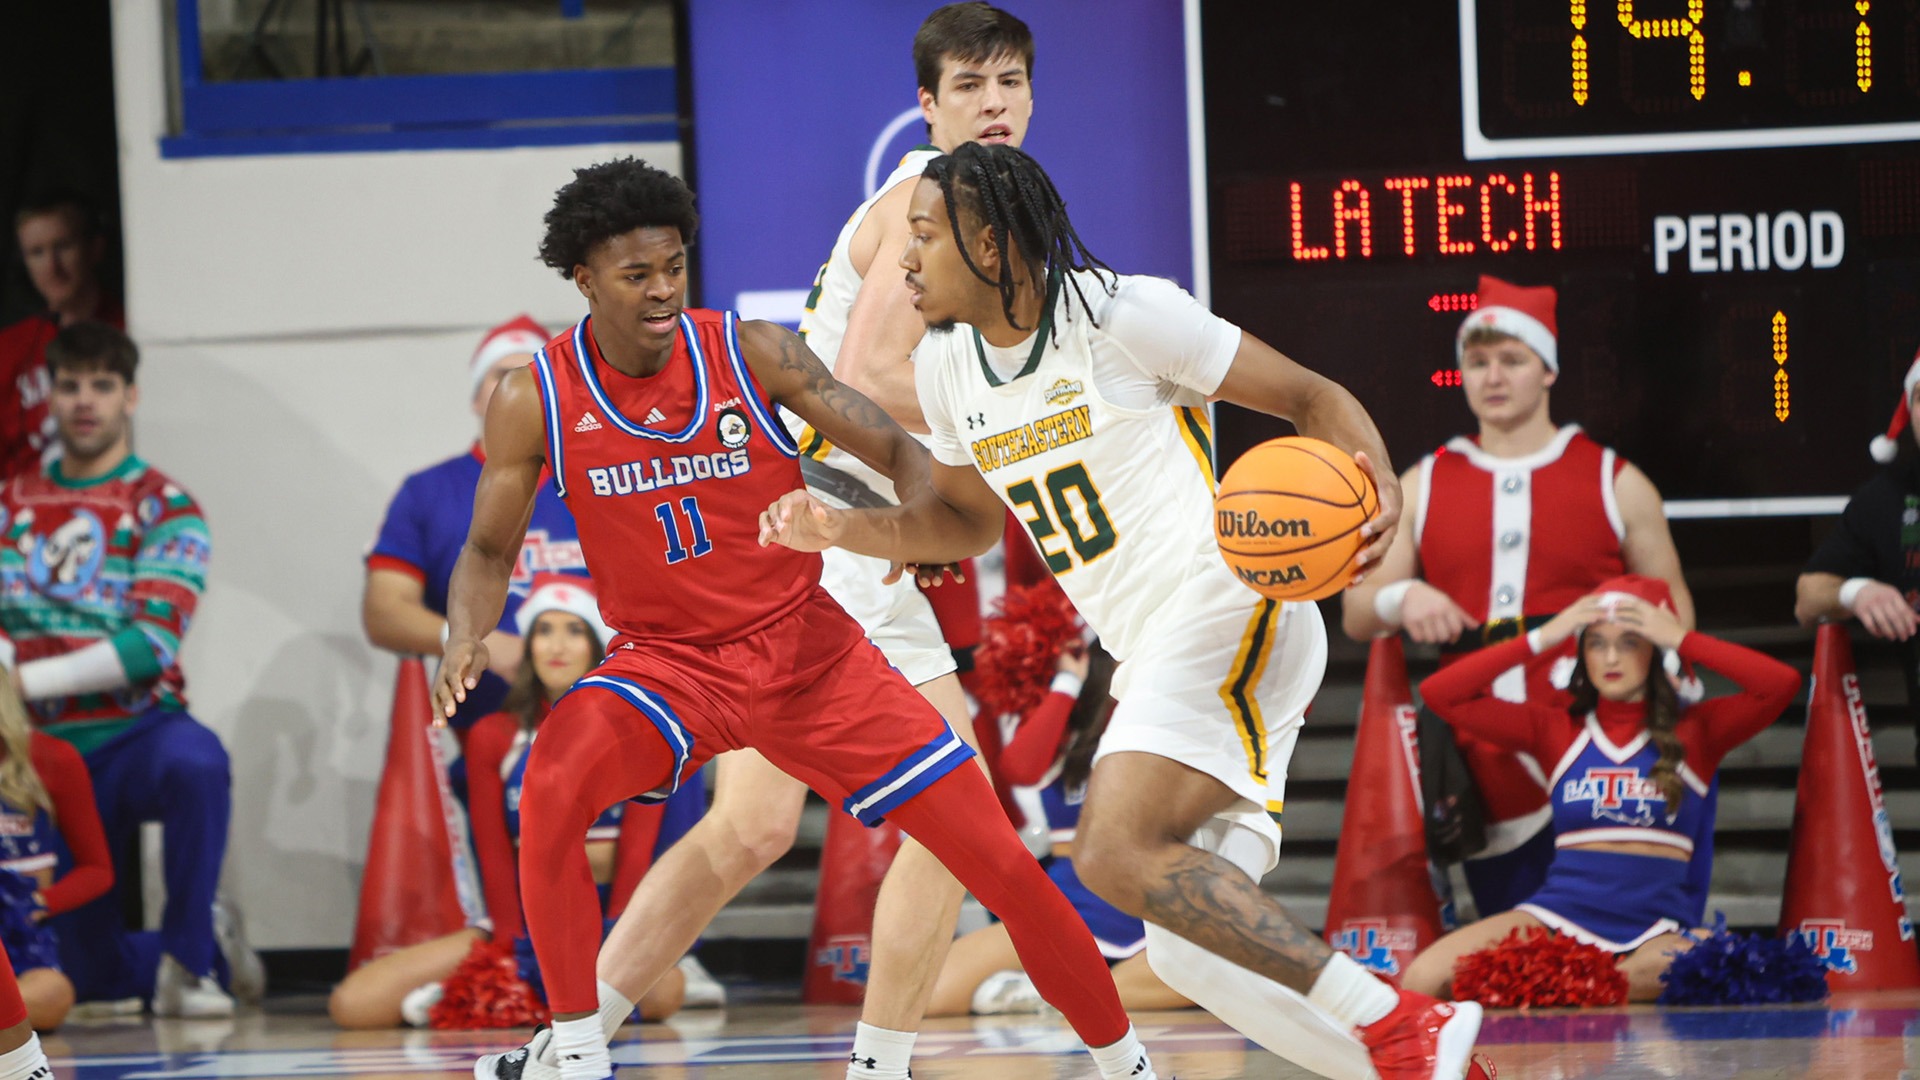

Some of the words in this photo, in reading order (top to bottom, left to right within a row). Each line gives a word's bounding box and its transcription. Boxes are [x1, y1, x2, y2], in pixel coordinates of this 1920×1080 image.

[1653, 210, 1846, 274] PERIOD
[1771, 310, 1790, 422] 1
[574, 422, 603, 433] adidas
[971, 404, 1094, 473] SOUTHEASTERN
[587, 449, 751, 496] BULLDOGS
[654, 496, 713, 565] 11
[1005, 459, 1120, 578] 20
[1217, 510, 1311, 538] Wilson
[1235, 564, 1307, 587] NCAA
